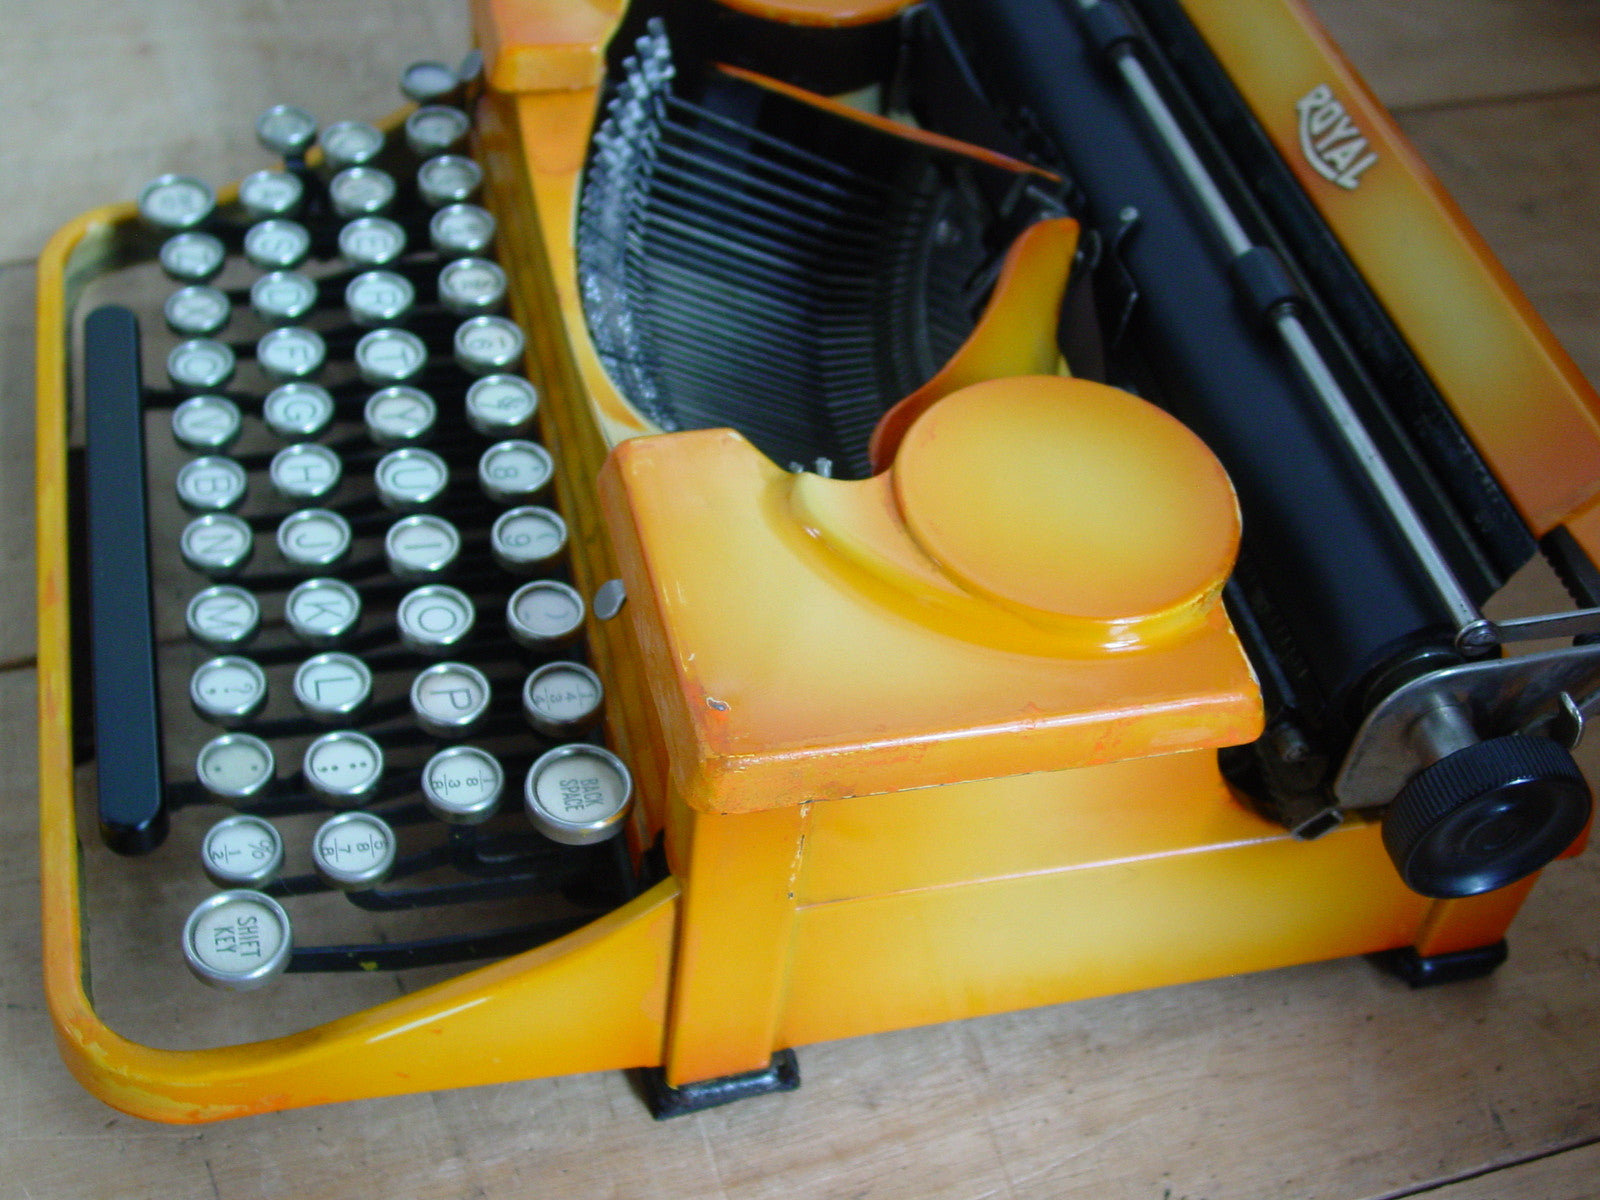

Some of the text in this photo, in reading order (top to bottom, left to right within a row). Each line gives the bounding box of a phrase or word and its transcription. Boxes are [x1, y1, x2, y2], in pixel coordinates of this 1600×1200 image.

[1296, 83, 1378, 189] ROYAL
[272, 345, 309, 361] F
[371, 347, 410, 371] T
[283, 400, 317, 422] G
[380, 406, 424, 425] Y
[286, 464, 326, 484] H
[390, 467, 432, 490] U
[491, 466, 519, 480] 8
[194, 475, 231, 496] B
[198, 533, 234, 555] N
[294, 532, 331, 549] J
[501, 532, 531, 547] 9
[202, 601, 242, 632] M
[302, 600, 342, 622] K
[313, 675, 354, 701] L
[429, 688, 472, 711] P
[559, 779, 584, 812] SPACE
[580, 777, 604, 807] BACK
[213, 926, 237, 956] KEY
[236, 916, 261, 958] SHIFT
